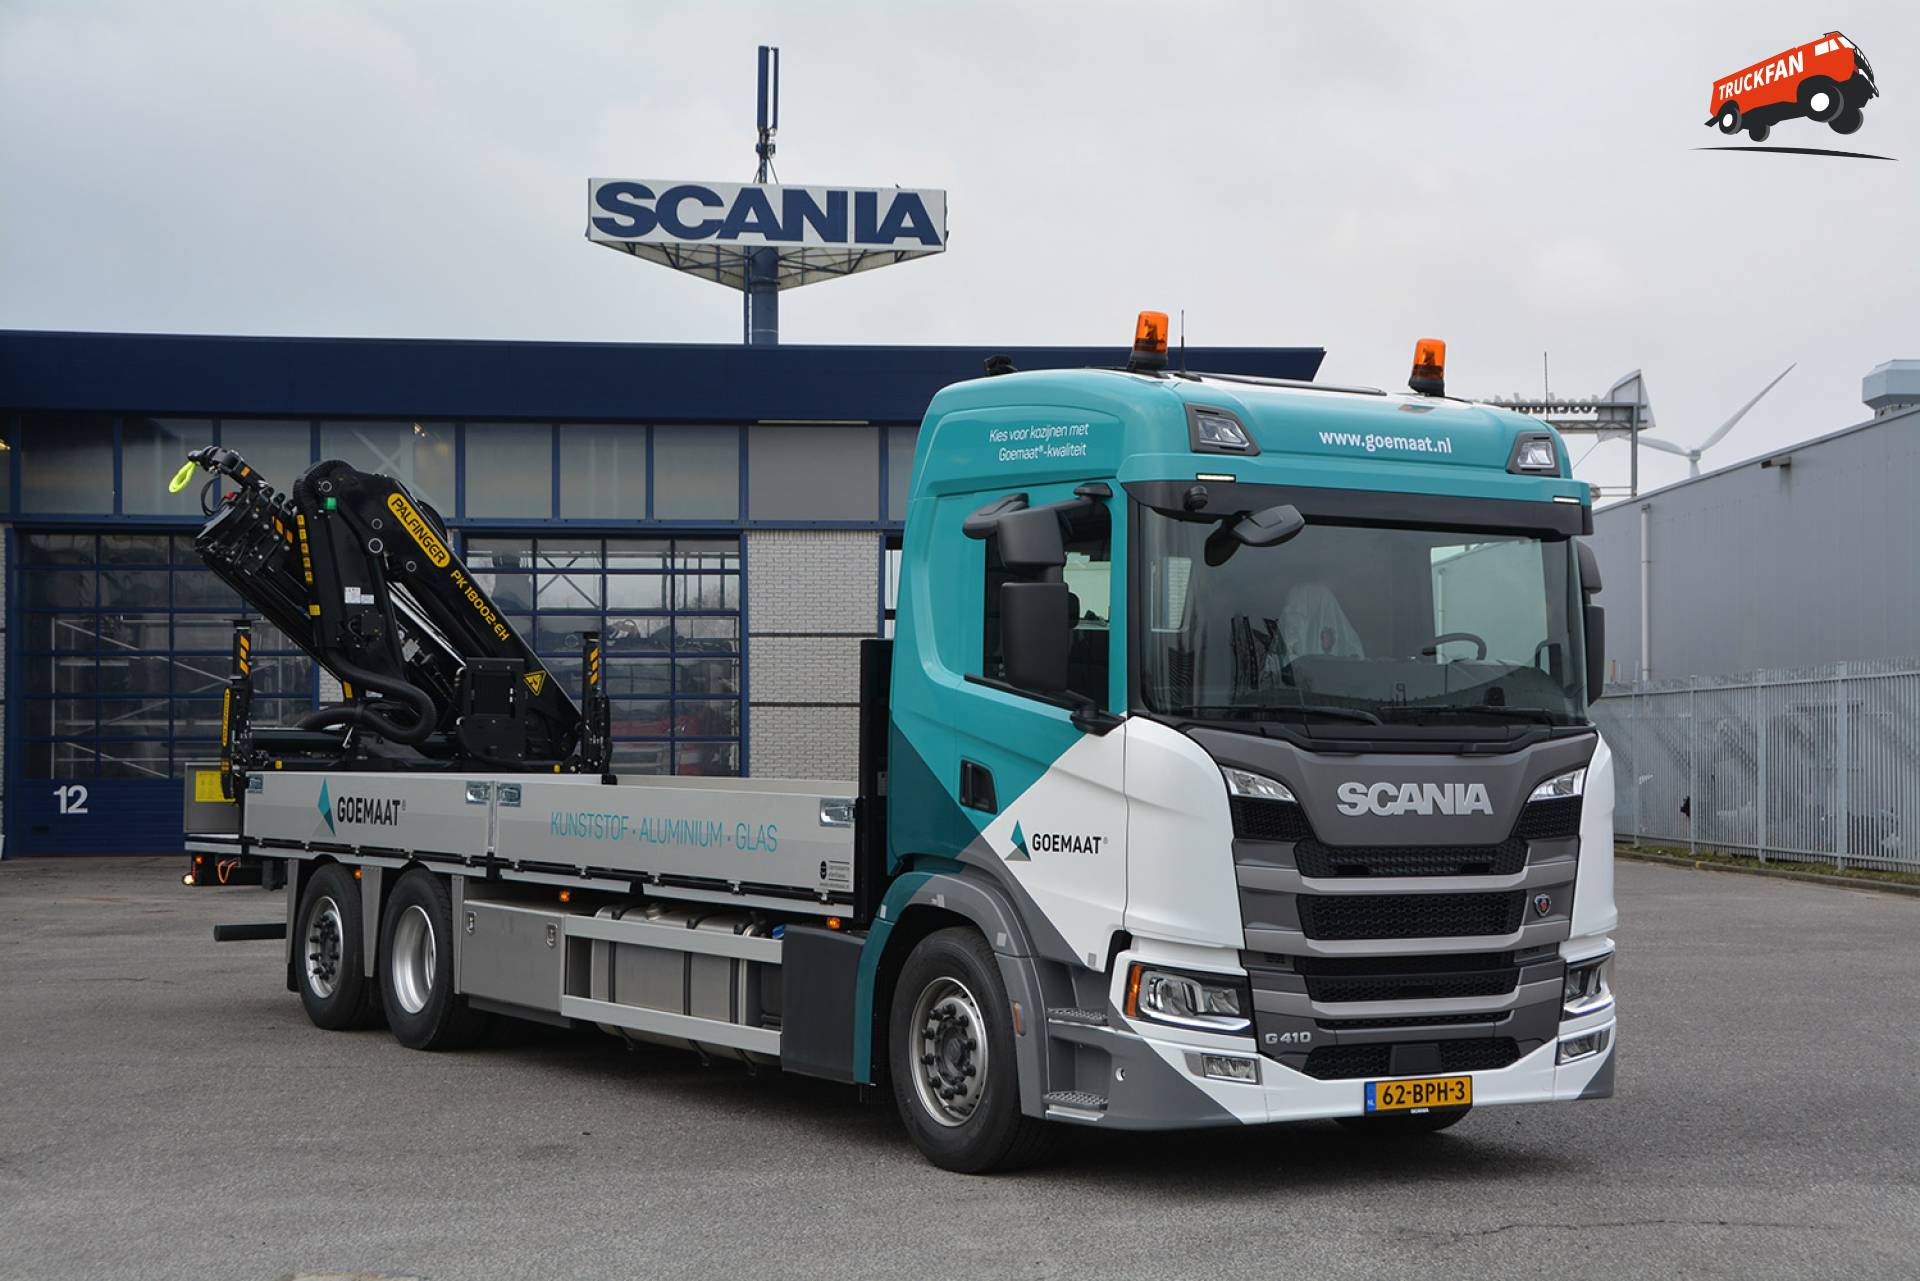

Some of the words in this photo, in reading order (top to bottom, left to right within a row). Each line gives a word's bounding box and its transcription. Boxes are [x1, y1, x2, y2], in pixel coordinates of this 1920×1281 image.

[592, 181, 942, 246] SCANIA
[989, 428, 1008, 443] Kies
[1010, 428, 1030, 441] voor
[1030, 425, 1067, 442] kozijnen
[1069, 423, 1090, 437] met
[1318, 431, 1452, 454] www.goemaat.nl
[391, 498, 447, 563] PALFINGER
[450, 569, 468, 589] PK
[53, 784, 89, 814] 12
[1336, 782, 1494, 816] SCANIA
[551, 811, 629, 841] KUNSTSTOF
[639, 816, 723, 849] ALUMINIUM
[735, 822, 778, 853] GLAS
[1382, 1080, 1465, 1105] 62-BPH-3
